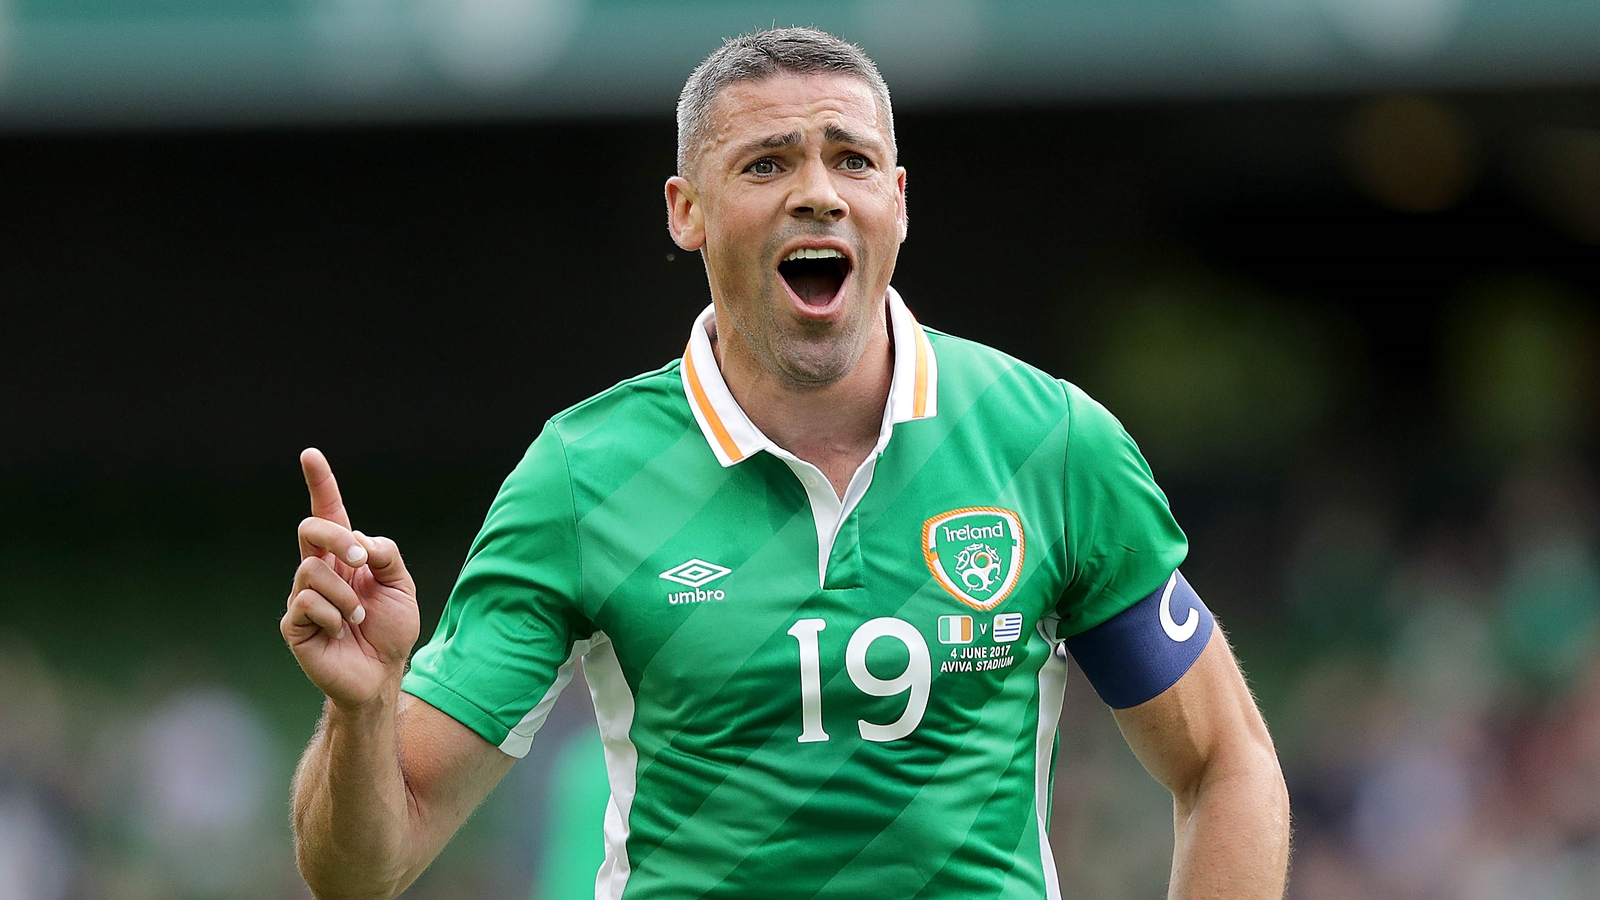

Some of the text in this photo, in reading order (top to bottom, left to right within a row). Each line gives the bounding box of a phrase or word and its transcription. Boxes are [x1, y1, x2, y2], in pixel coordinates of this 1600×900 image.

[943, 521, 1004, 542] Ireland
[668, 588, 725, 604] umbro
[1159, 570, 1199, 642] C
[950, 645, 1011, 659] 4 JUNE 2017
[940, 656, 1014, 672] AVIVA STADIUM
[787, 616, 932, 742] 19
